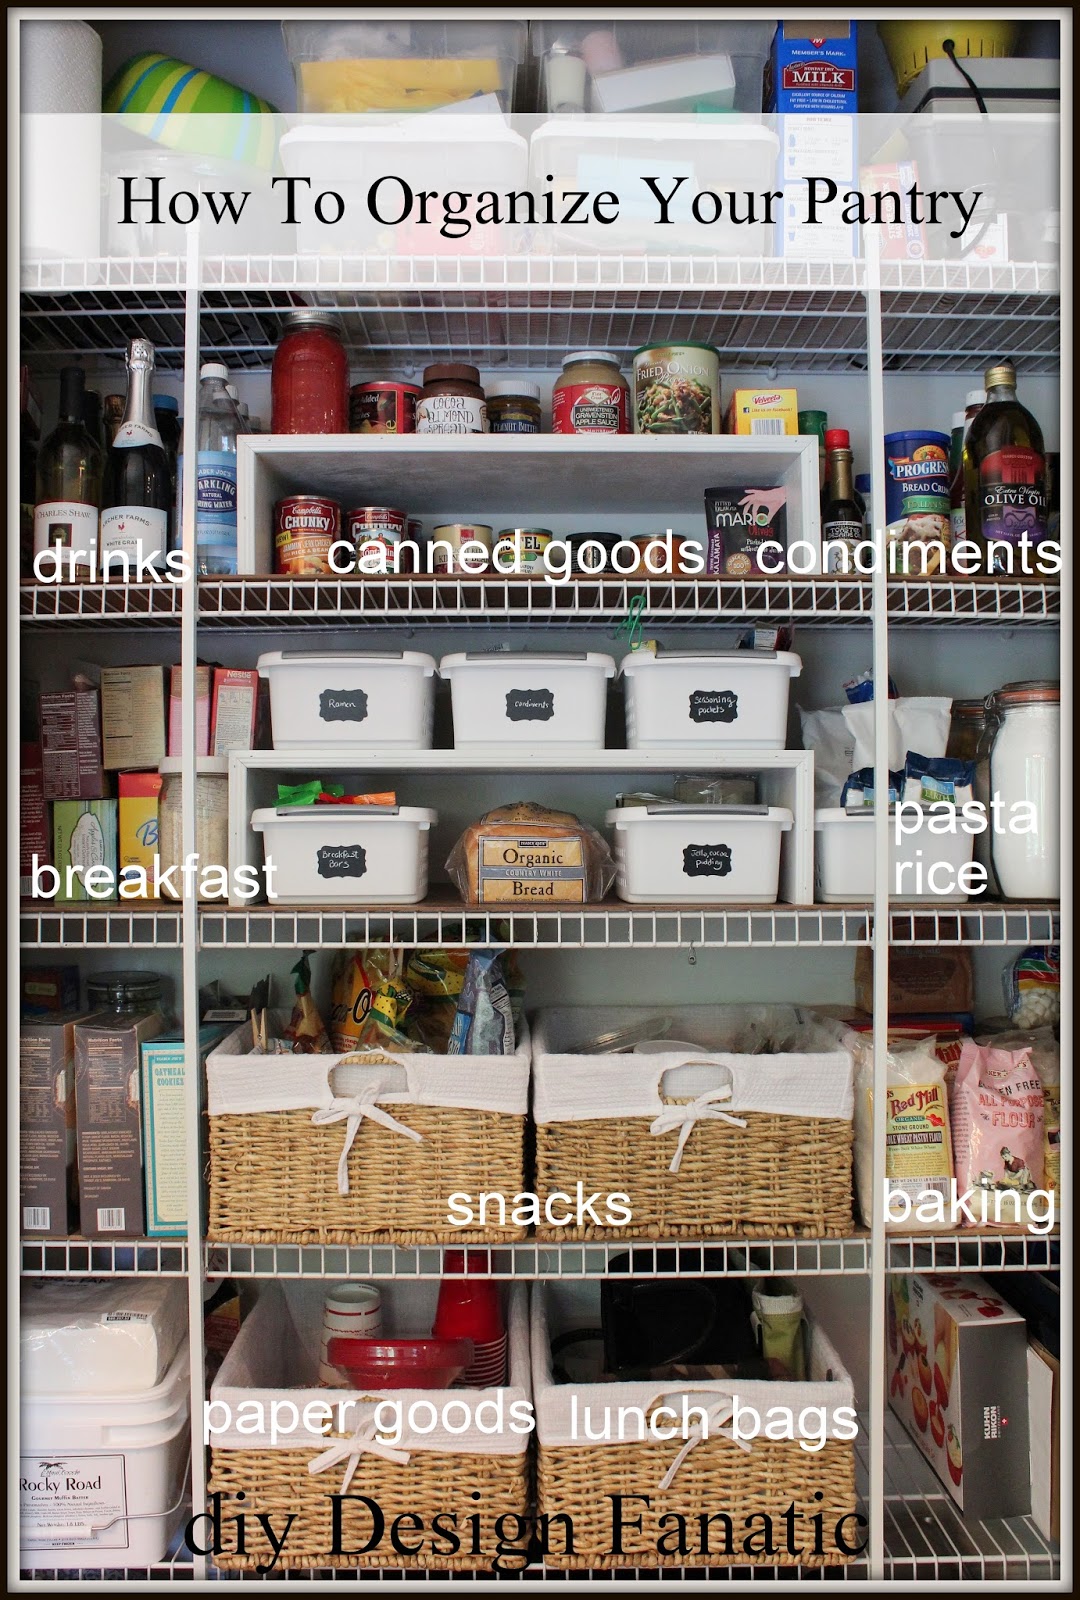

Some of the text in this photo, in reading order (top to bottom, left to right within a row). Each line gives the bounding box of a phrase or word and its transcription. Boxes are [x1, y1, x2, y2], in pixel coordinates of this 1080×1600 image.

[792, 71, 846, 84] MILK
[637, 366, 663, 381] FRIED
[667, 361, 709, 377] ONION
[597, 419, 618, 427] SAUCE
[198, 480, 236, 496] ARKLING
[902, 482, 930, 492] BREAD
[994, 485, 1041, 496] Extra Virgin
[197, 500, 233, 508] RING WATER
[984, 493, 1046, 507] OLIVE OIL
[36, 508, 91, 519] CHARLES SHAW
[125, 514, 150, 527] FARMS
[285, 515, 331, 531] CHUNKY
[713, 533, 721, 575] KALAMATA
[328, 698, 357, 709] Ramen
[322, 849, 360, 860] Breakfast
[502, 848, 564, 868] Organic
[328, 859, 351, 869] Bars
[504, 869, 562, 877] COUNTRY WHITE
[512, 880, 555, 896] Bread
[1015, 1080, 1041, 1092] FREE
[890, 1086, 940, 1119] Red Mill
[978, 1094, 1045, 1108] ALL PURPOSE
[991, 1111, 1036, 1129] FLOUR
[20, 1477, 60, 1495] Rocky
